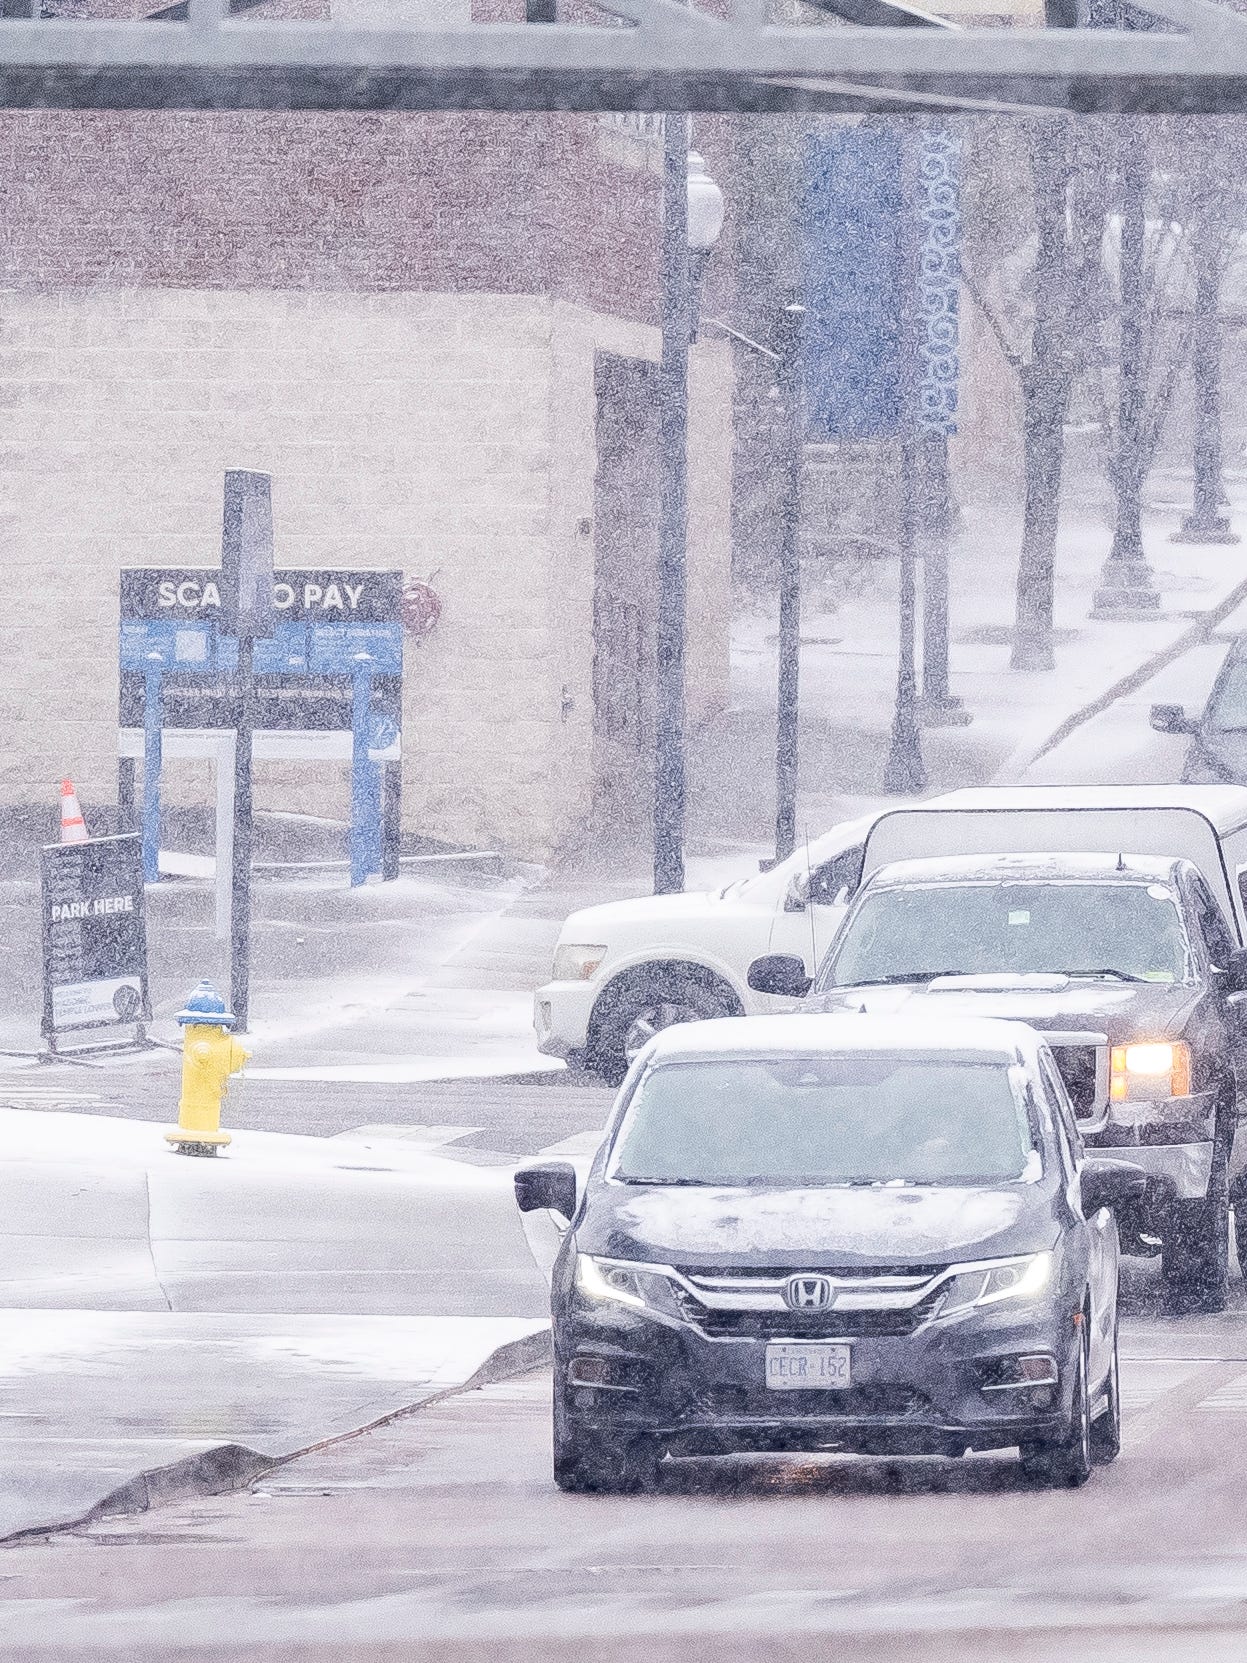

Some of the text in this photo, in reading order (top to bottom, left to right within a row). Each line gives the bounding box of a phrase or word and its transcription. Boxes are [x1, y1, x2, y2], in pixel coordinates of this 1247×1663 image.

[158, 581, 364, 609] SCA O PAY
[52, 895, 134, 921] PARK HERE
